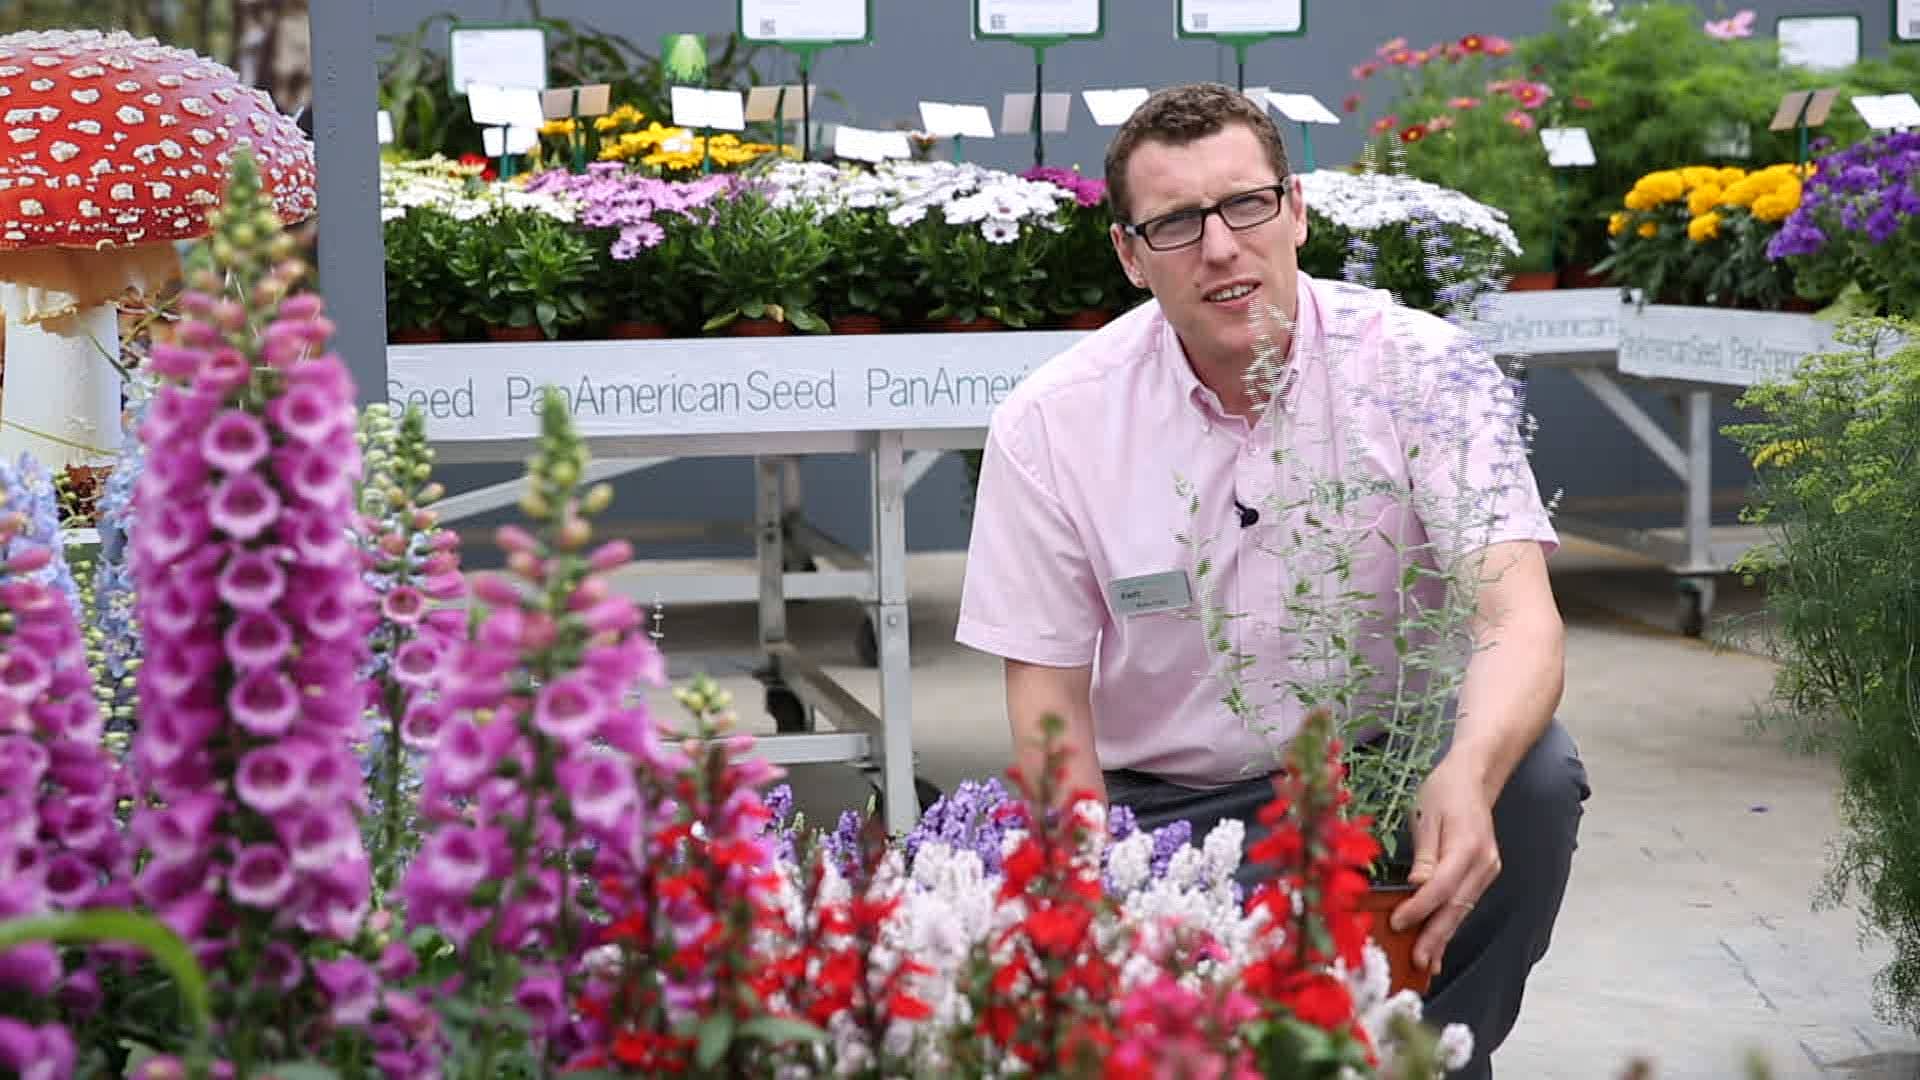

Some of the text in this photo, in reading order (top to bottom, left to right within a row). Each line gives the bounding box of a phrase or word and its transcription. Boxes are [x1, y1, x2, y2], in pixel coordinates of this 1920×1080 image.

[387, 377, 474, 419] Seed
[507, 374, 740, 417] PanAmerican
[747, 368, 836, 411] Seed
